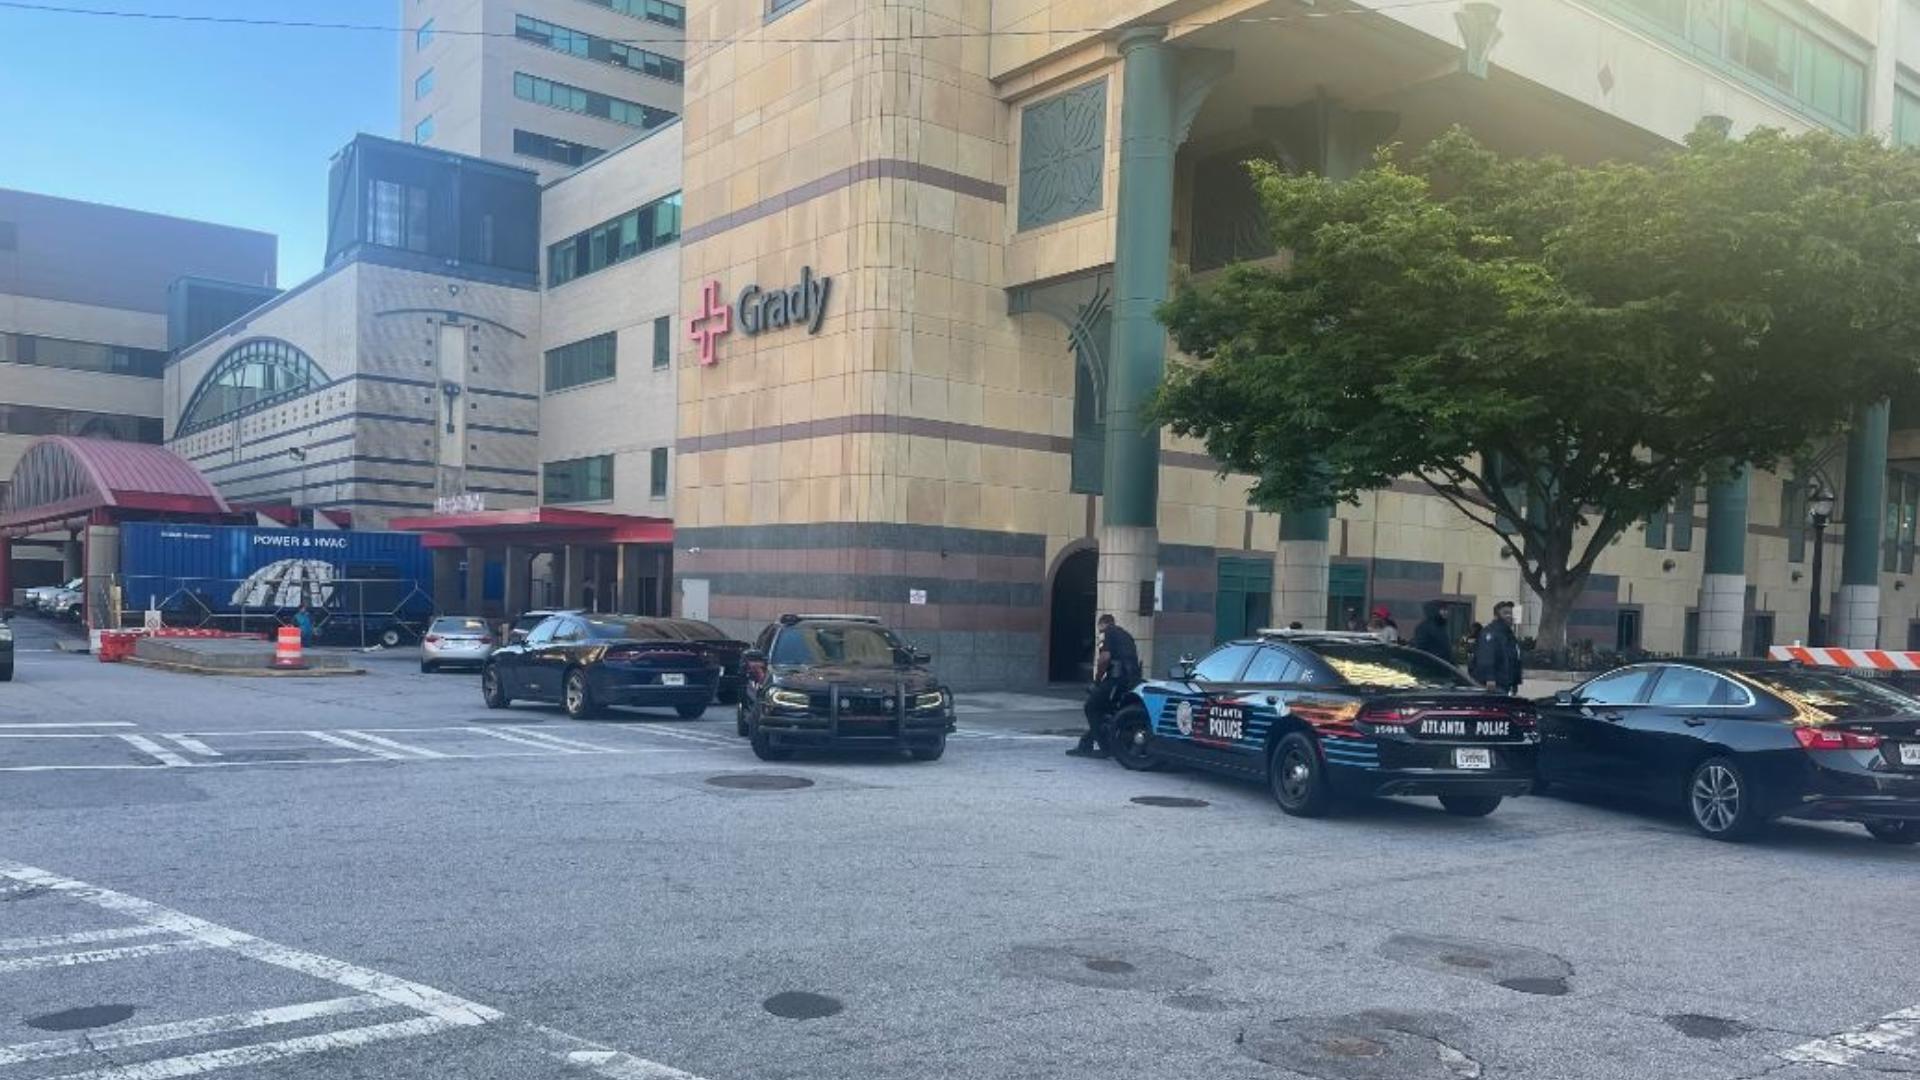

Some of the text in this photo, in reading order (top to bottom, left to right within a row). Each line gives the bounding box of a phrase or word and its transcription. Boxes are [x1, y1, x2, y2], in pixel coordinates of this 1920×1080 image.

[736, 266, 831, 336] Grady
[253, 534, 348, 549] POWER & HVAC
[1209, 706, 1243, 719] ATLANTA
[1209, 718, 1243, 740] POLICE
[1420, 719, 1510, 736] ATLANTA POLICE
